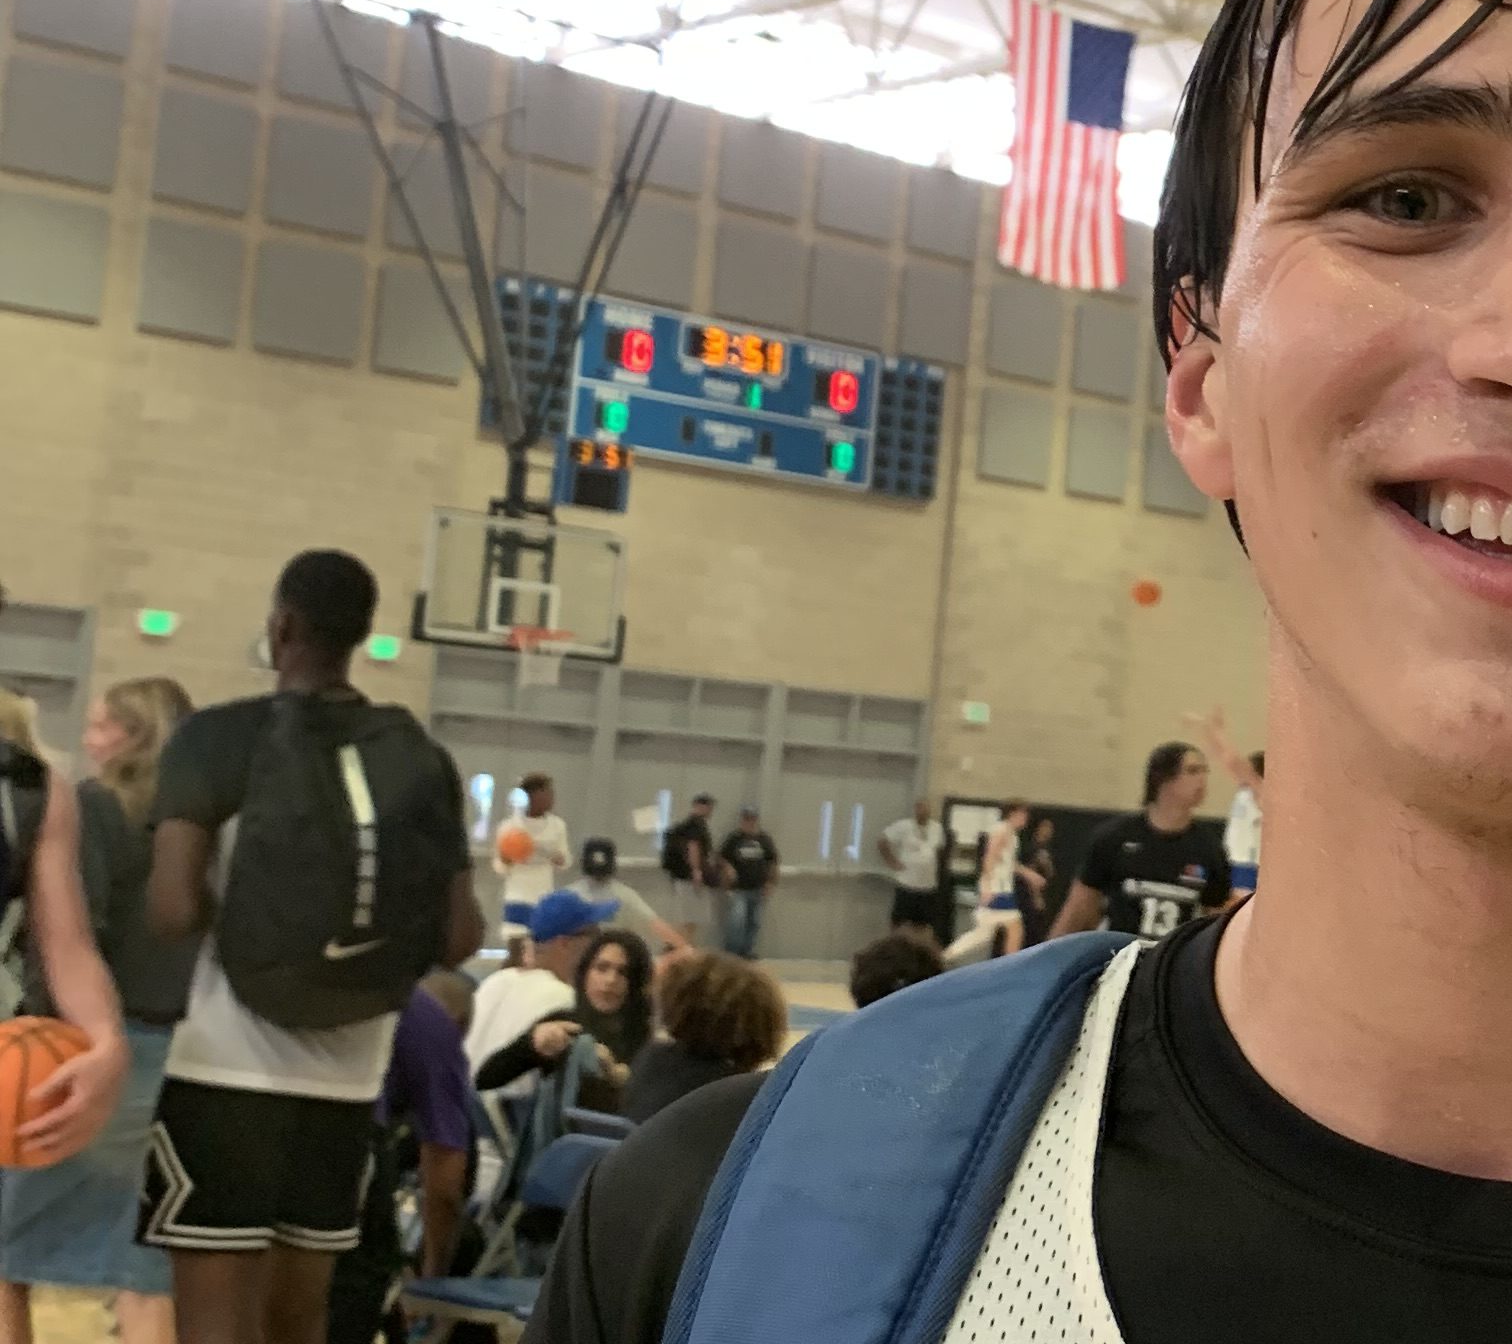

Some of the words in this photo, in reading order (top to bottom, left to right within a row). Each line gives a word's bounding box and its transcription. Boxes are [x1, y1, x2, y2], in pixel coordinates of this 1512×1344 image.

[622, 328, 655, 374] 0
[703, 325, 785, 376] 3:51
[829, 369, 860, 414] 0
